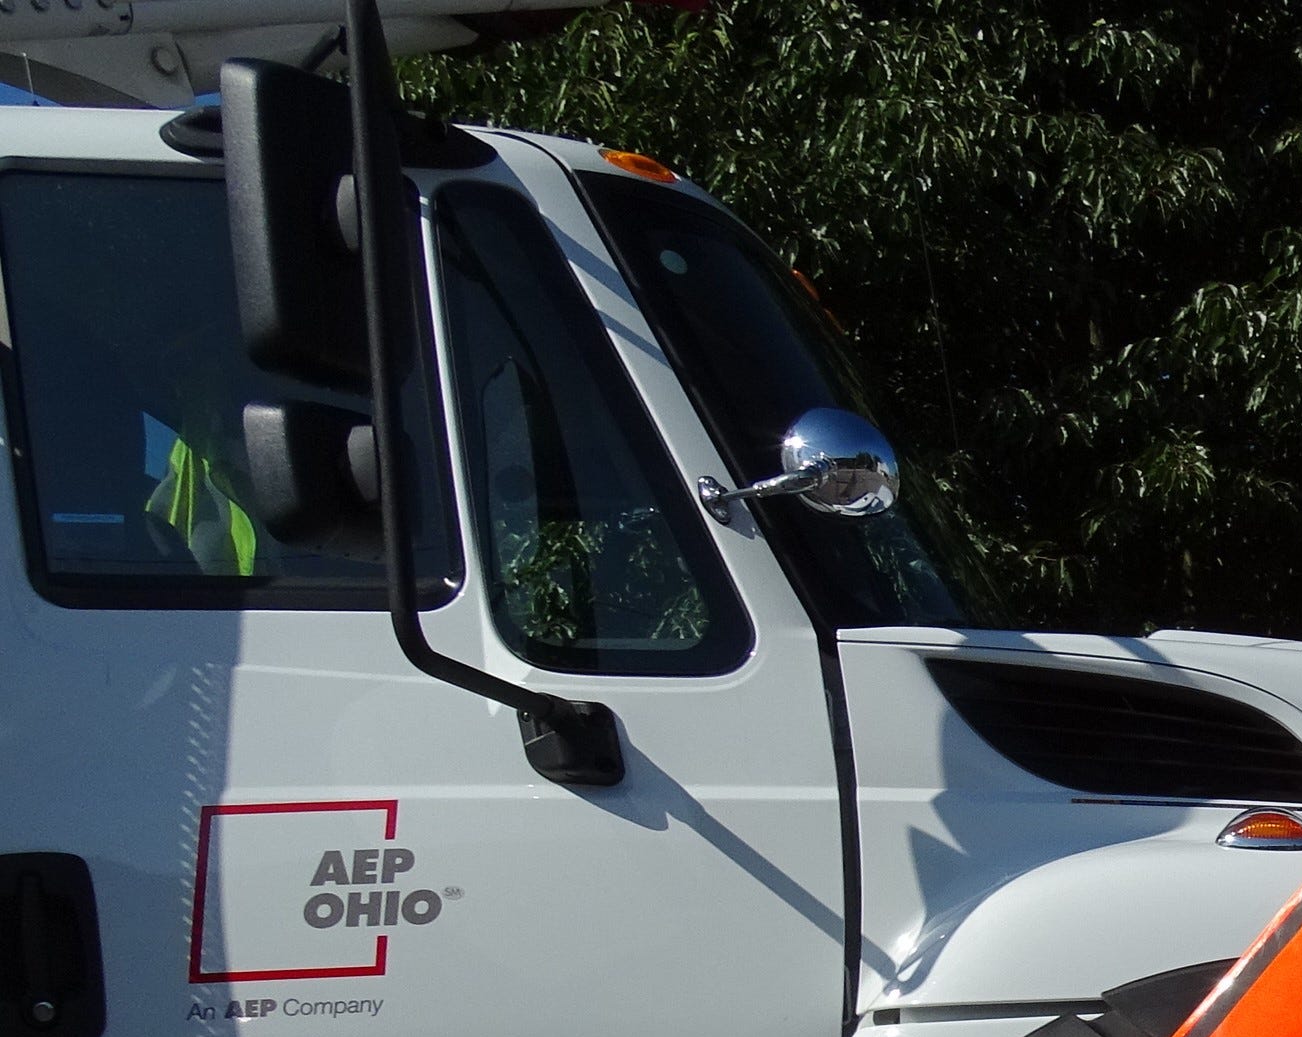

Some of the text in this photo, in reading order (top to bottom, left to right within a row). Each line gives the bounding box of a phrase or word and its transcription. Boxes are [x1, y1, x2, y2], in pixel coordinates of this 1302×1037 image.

[310, 848, 415, 886] AEP
[303, 889, 442, 929] OHIO
[186, 998, 384, 1020] An AEP Company
